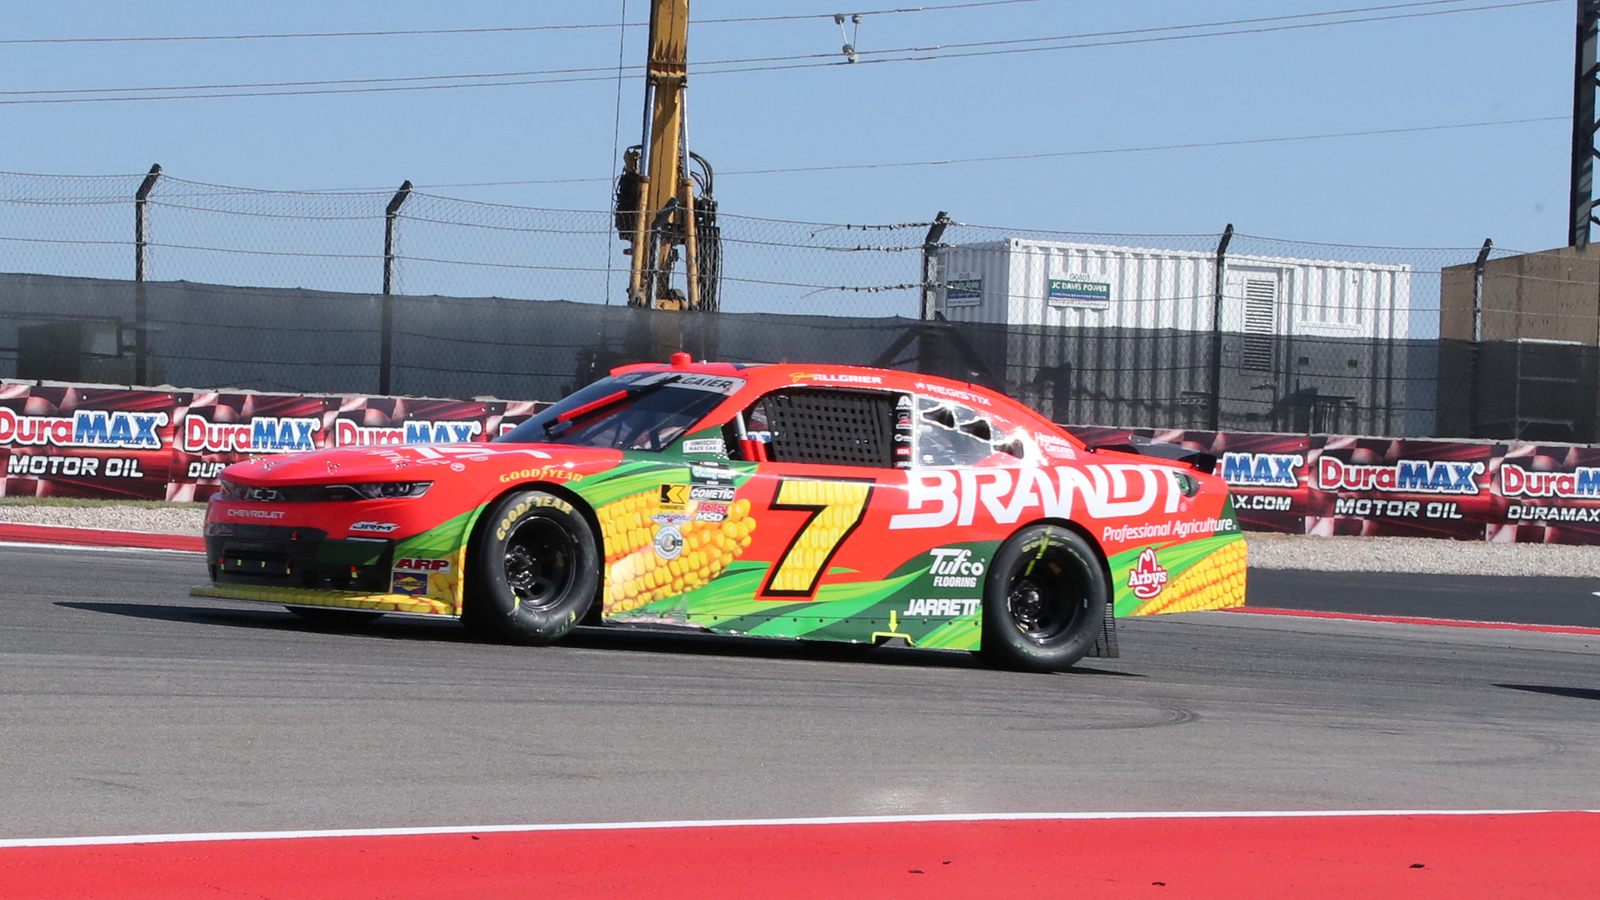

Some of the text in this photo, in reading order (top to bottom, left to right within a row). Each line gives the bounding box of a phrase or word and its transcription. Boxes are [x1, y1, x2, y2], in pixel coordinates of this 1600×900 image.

[1062, 282, 1082, 291] DAVIS
[1083, 284, 1108, 292] POWER
[926, 384, 992, 406] REGISTIX
[8, 454, 144, 478] MOTOR OIL
[499, 466, 584, 483] GOODYEAR
[1320, 458, 1479, 494] DuraMAX
[889, 464, 1180, 530] BRANDT
[228, 509, 285, 518] CHEVROLET
[496, 496, 574, 541] GOODYEAR
[695, 512, 724, 521] MSD
[1335, 498, 1463, 519] MOTOR OIL
[760, 475, 877, 597] 7
[1102, 517, 1233, 543] Professional Agriculture
[394, 558, 450, 571] ARP
[929, 548, 985, 576] Tufco
[933, 576, 977, 588] FLOORING
[903, 599, 980, 616] JARRETT
